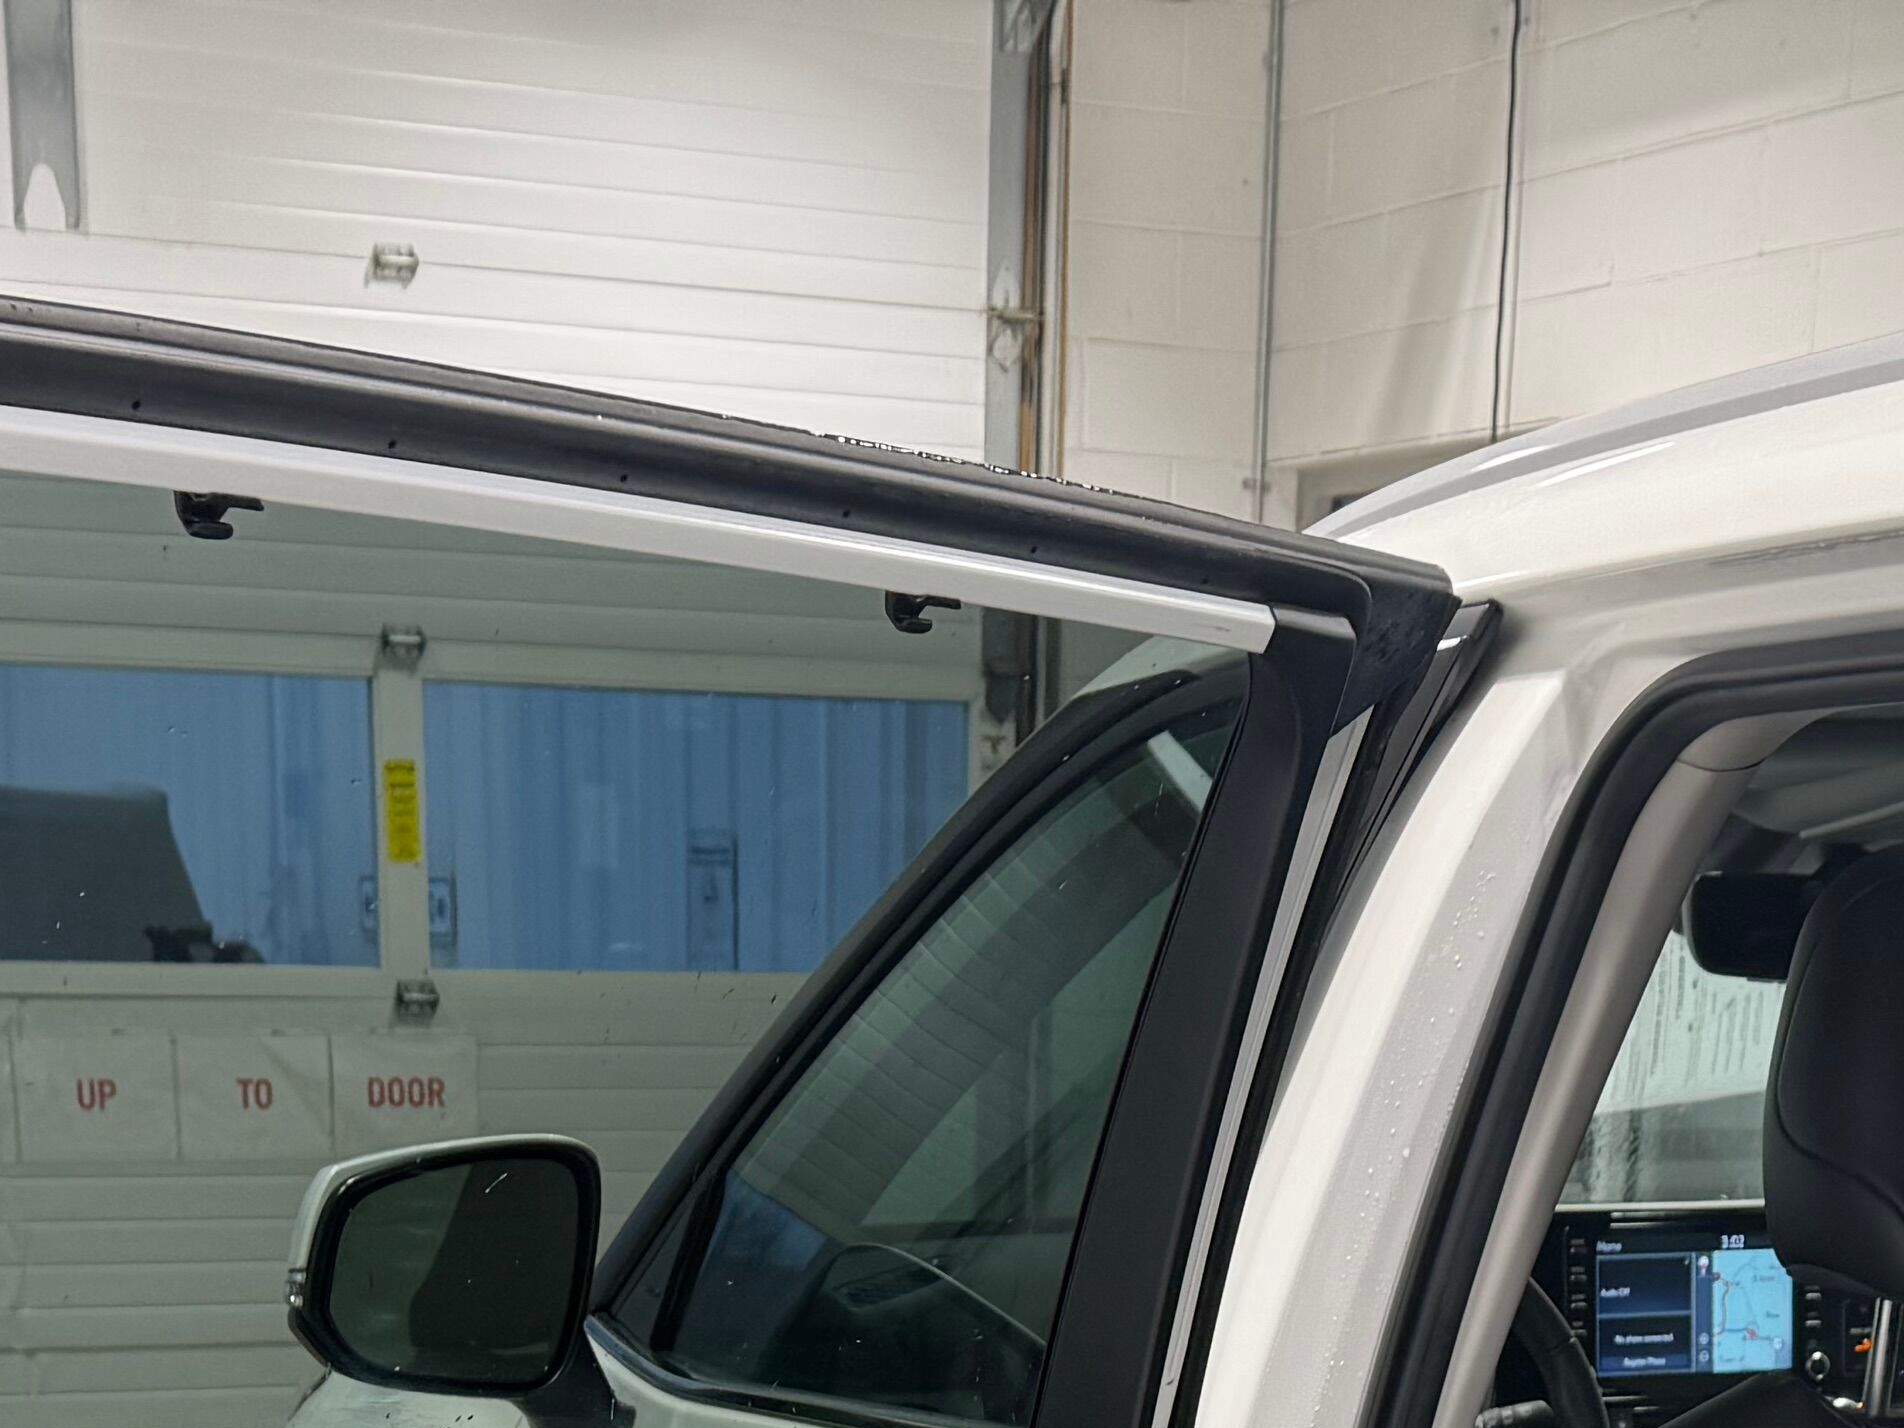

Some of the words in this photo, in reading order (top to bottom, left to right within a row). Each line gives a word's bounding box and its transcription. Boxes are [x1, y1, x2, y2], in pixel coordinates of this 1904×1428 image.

[76, 1079, 117, 1111] UP
[237, 1078, 273, 1110] TO
[368, 1077, 446, 1109] DOOR
